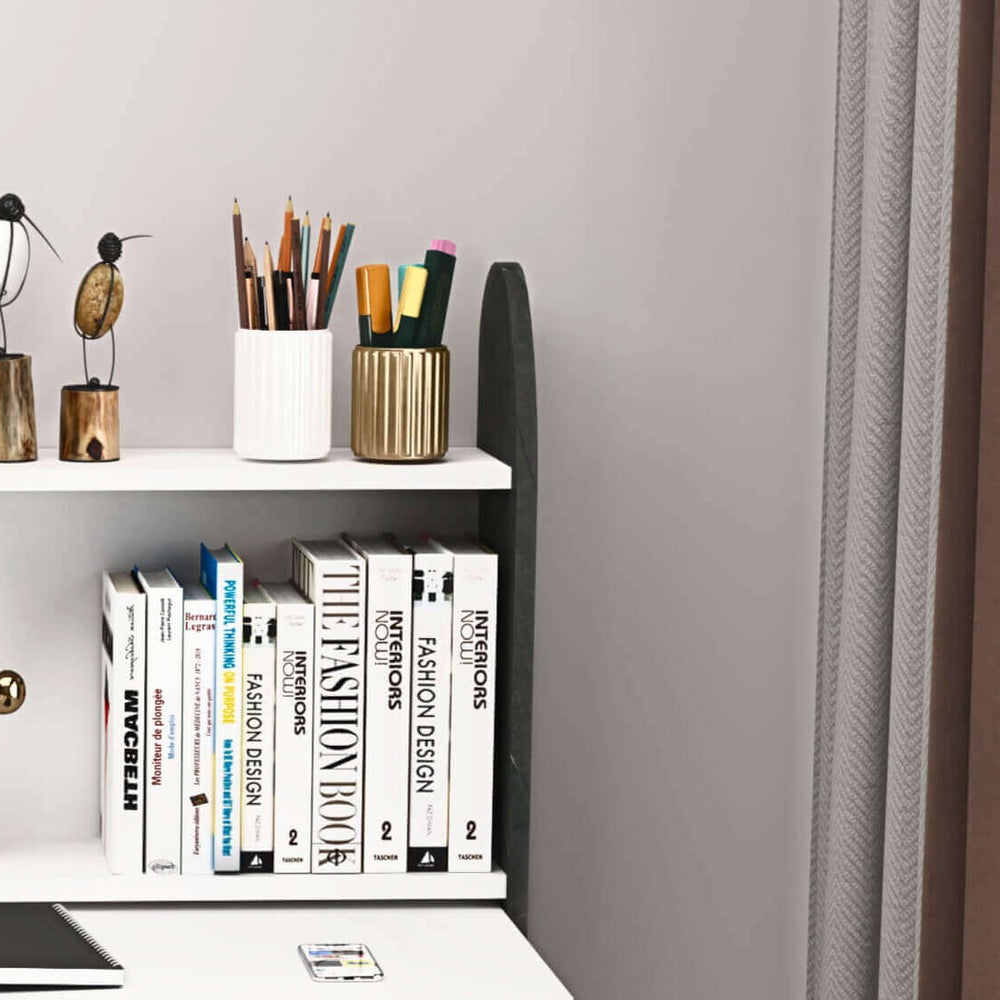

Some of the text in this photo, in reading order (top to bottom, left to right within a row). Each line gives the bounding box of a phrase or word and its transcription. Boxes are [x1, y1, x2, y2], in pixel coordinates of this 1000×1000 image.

[222, 580, 237, 724] POWERFUL THINKING ON PURPOSE
[282, 651, 294, 698] NOW!
[374, 610, 388, 665] NOW!
[388, 610, 403, 710] INTERIORS
[459, 610, 474, 665] NOW!
[474, 610, 488, 710] INTERIORS
[151, 689, 164, 786] Moniteur de plongée
[294, 651, 306, 736] INTERIORS
[318, 565, 361, 867] THE FASHION BOOK
[416, 637, 436, 794] FASHION DESIGN
[246, 673, 263, 806] FASHION DESIGN
[288, 829, 299, 846] 2
[381, 821, 393, 841] 2
[466, 821, 477, 840] 2
